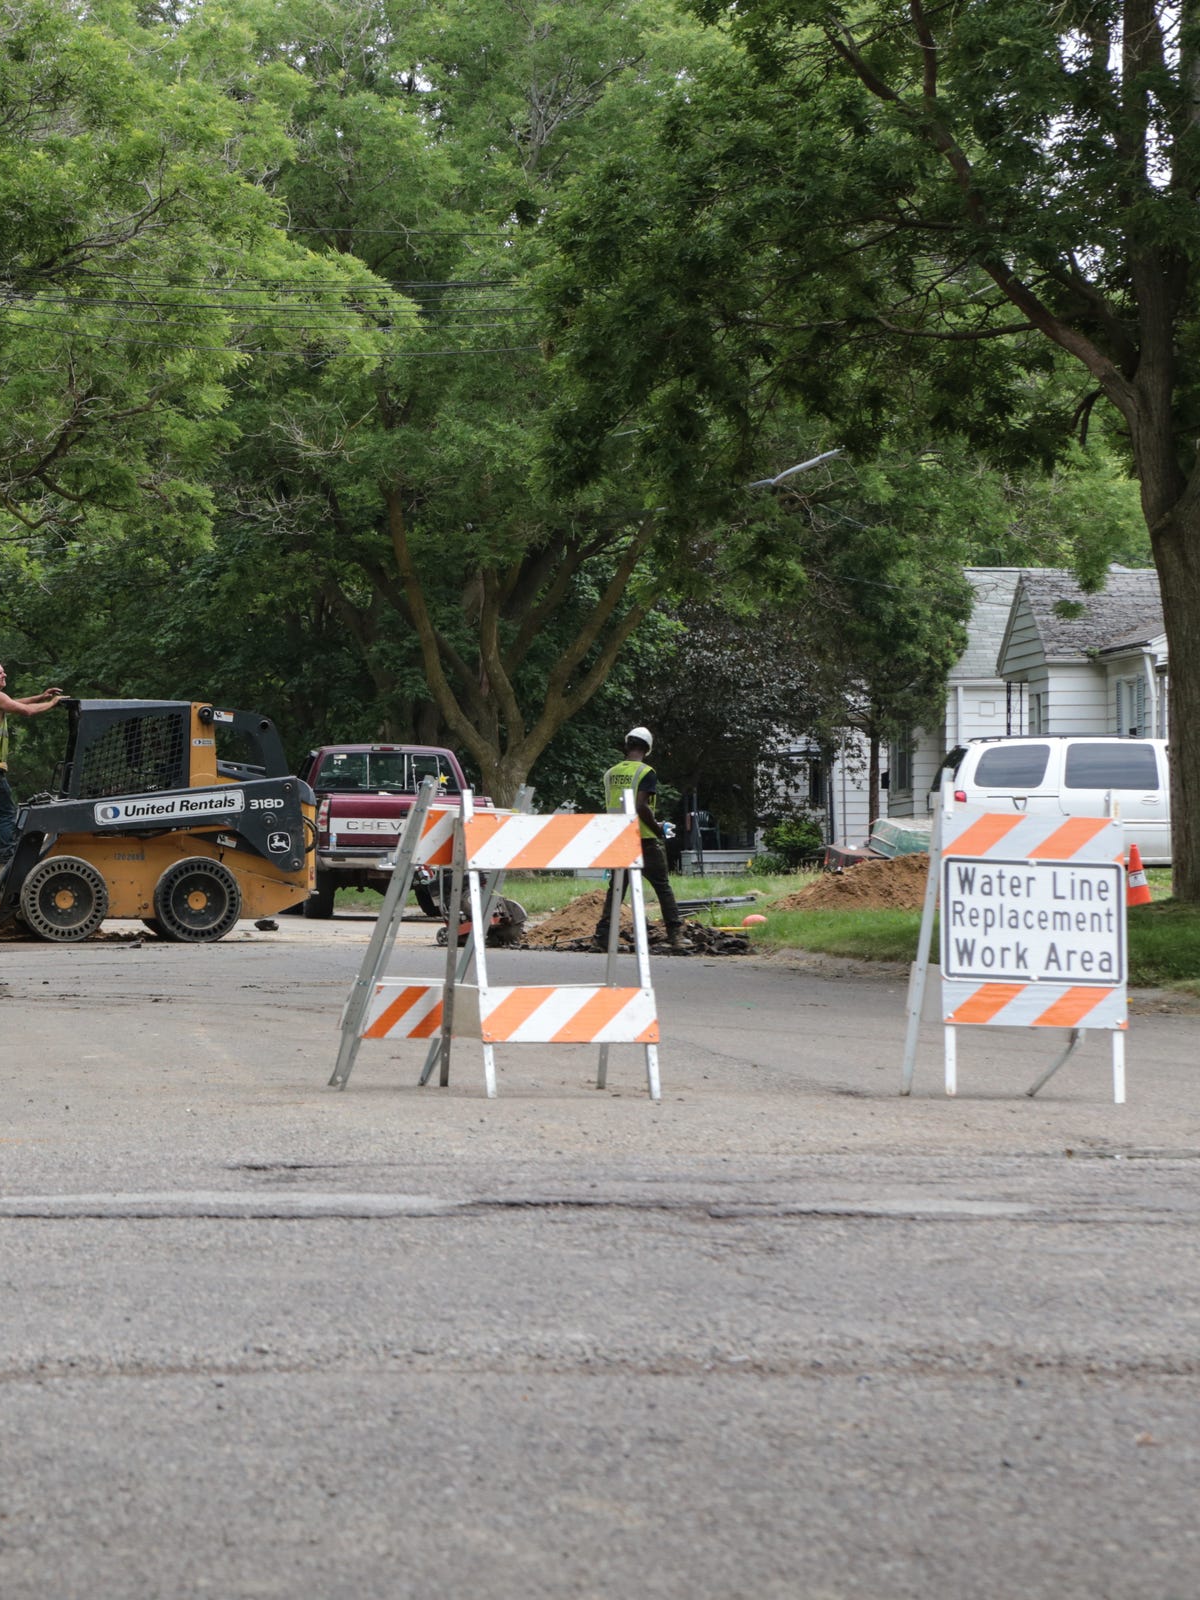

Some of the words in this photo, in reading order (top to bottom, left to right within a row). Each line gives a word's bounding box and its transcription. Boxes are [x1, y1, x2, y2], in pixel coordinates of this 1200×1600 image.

[124, 804, 175, 817] United
[179, 797, 236, 811] Rentals
[250, 799, 285, 809] 318D
[346, 820, 407, 831] CHEV
[957, 866, 1037, 898] Water
[1052, 871, 1110, 902] Line
[952, 900, 1114, 936] Replacement
[955, 937, 1029, 970] Work
[1044, 942, 1113, 973] Area
